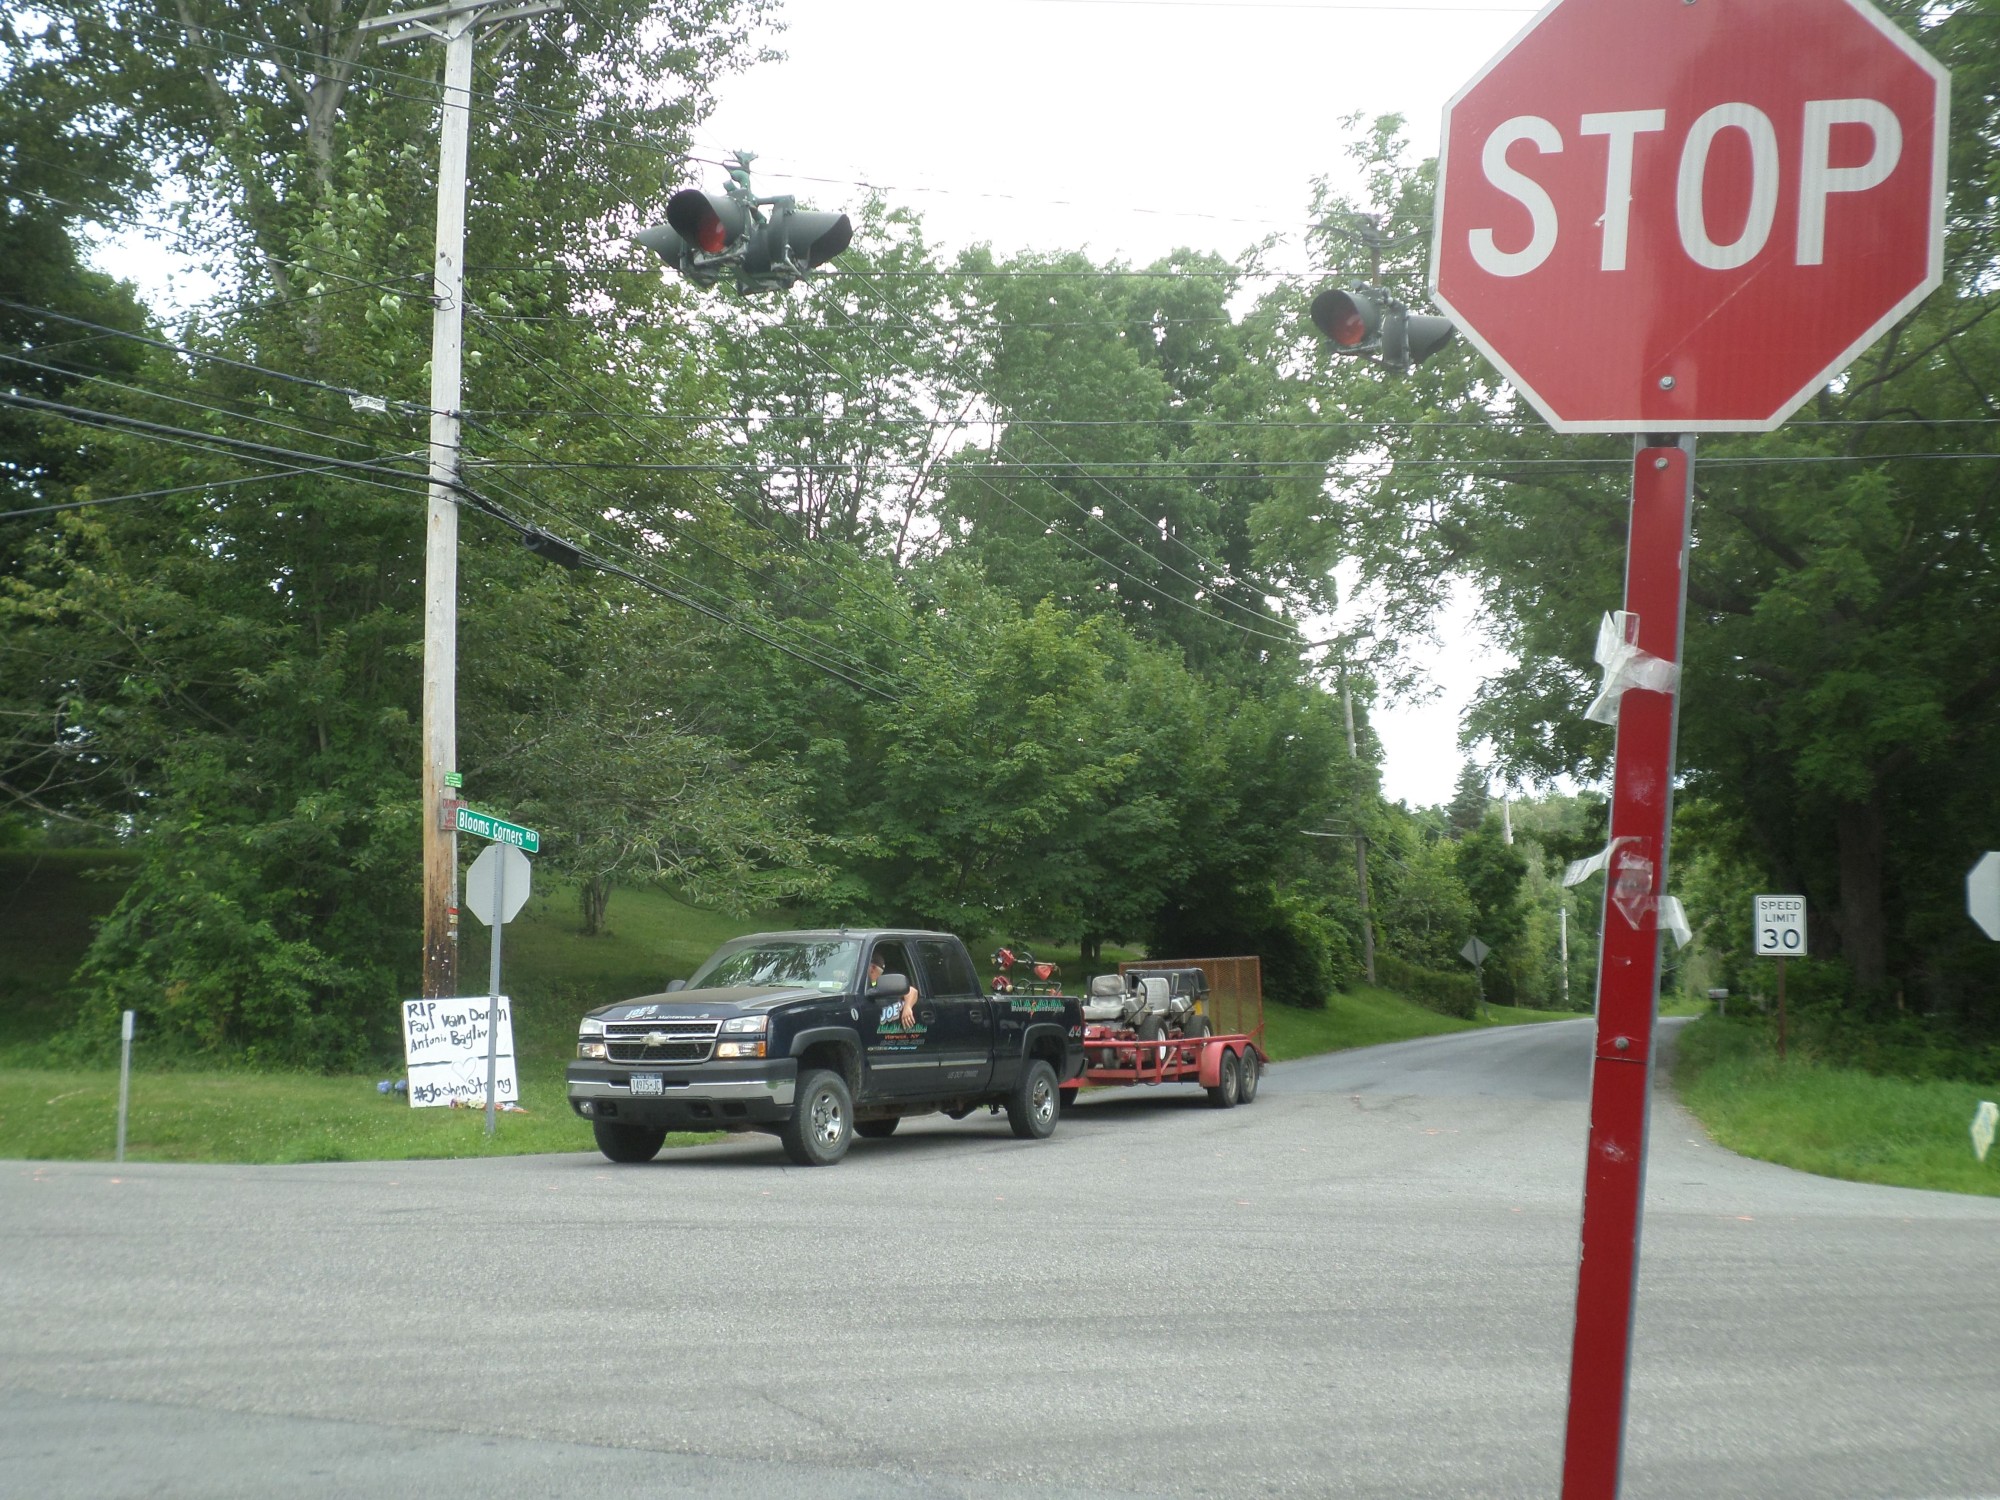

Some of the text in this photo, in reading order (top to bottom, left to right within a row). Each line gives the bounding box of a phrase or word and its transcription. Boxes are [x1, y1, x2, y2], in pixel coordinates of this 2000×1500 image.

[1468, 98, 1902, 277] STOP
[459, 811, 490, 836] Blooms
[493, 822, 523, 846] Corners
[525, 831, 536, 842] RD
[1761, 901, 1801, 910] SPEED
[1765, 914, 1797, 922] LIMIT
[1763, 928, 1800, 949] 30
[407, 1002, 436, 1018] RIP
[624, 1005, 658, 1020] JOE'S
[880, 1001, 905, 1025] JOE'
[408, 1015, 435, 1035] Paul
[468, 1008, 507, 1022] Dorn
[450, 1024, 498, 1049] Bagliv
